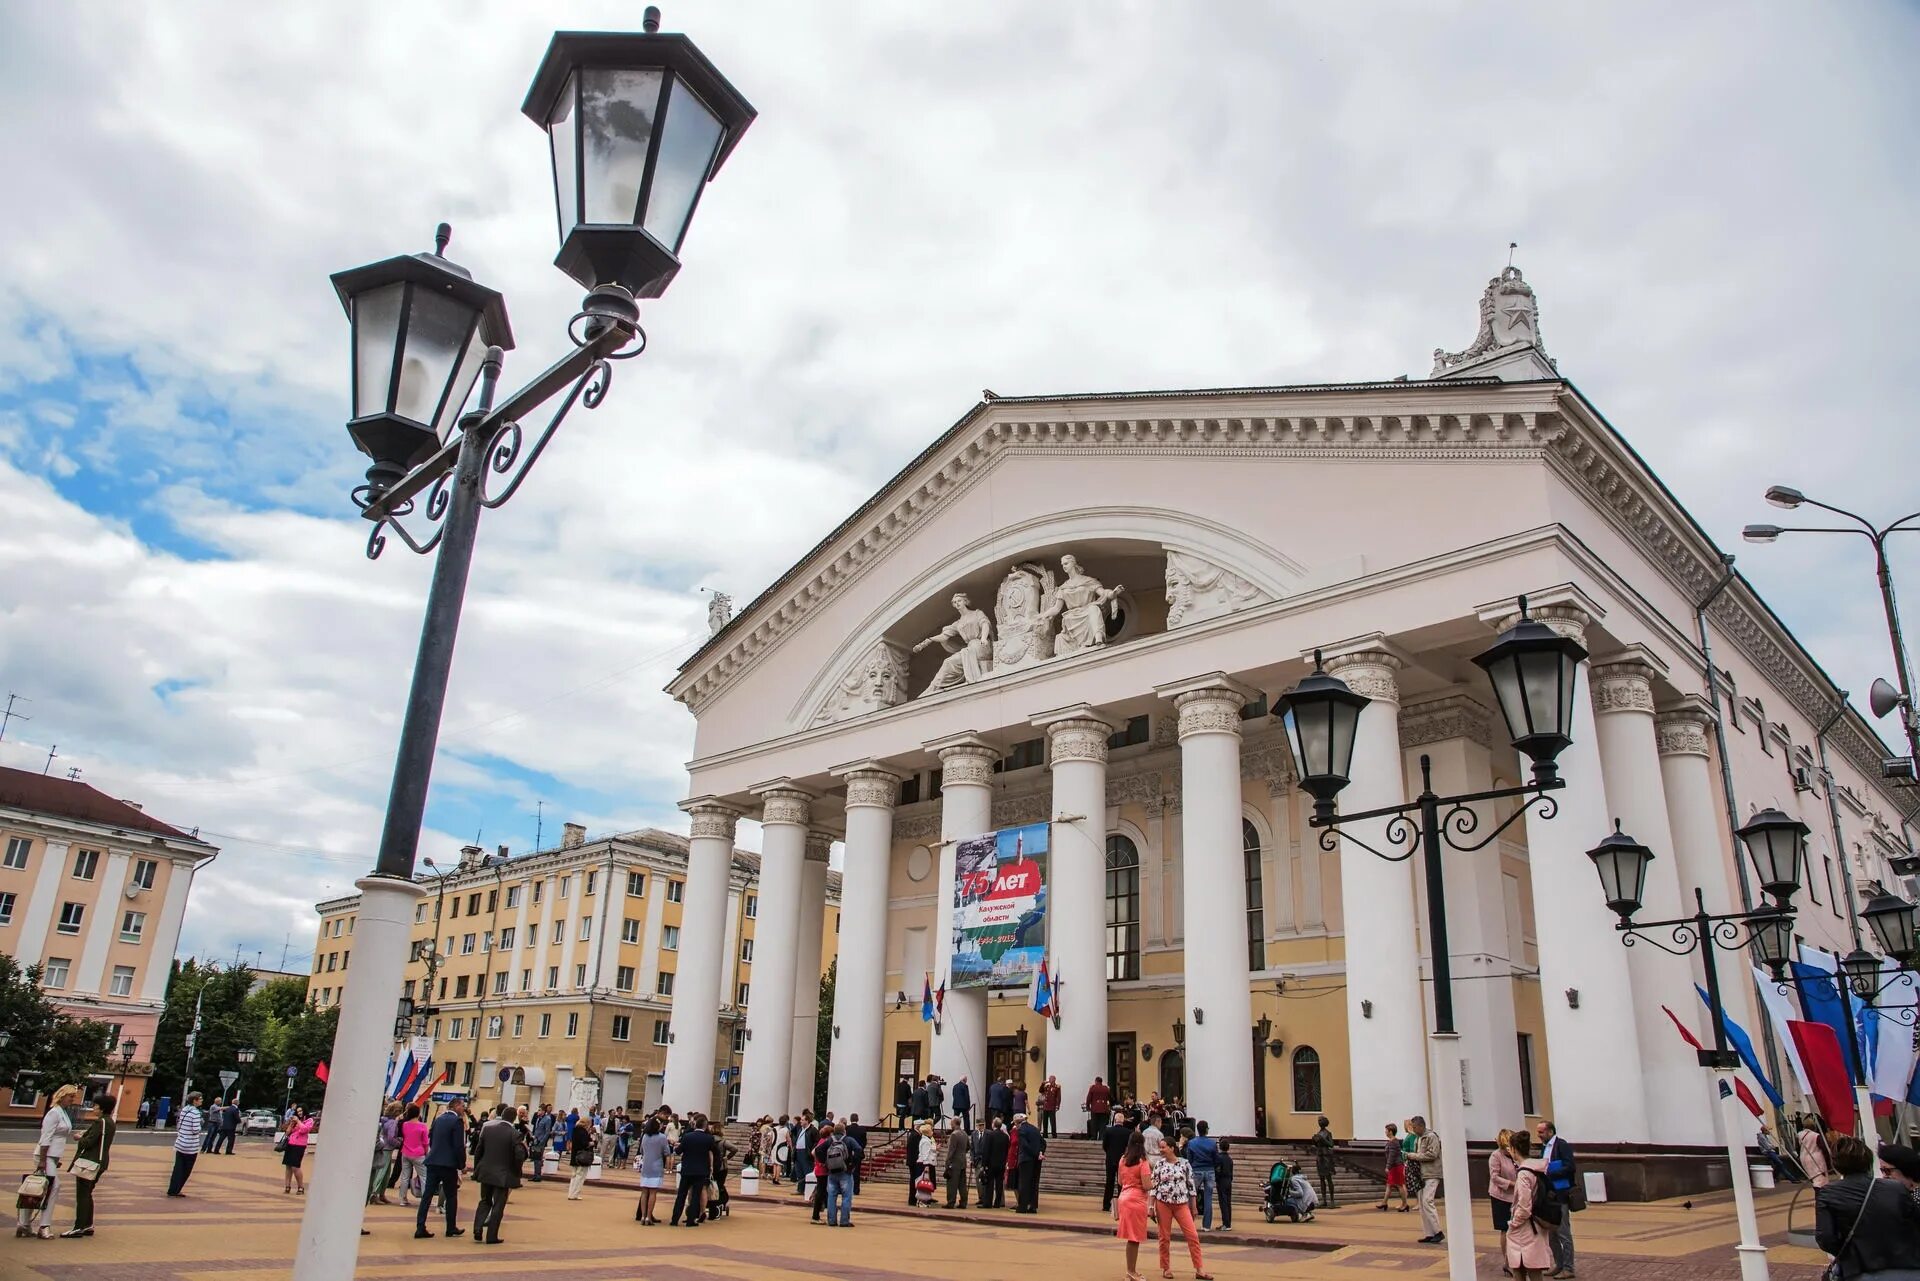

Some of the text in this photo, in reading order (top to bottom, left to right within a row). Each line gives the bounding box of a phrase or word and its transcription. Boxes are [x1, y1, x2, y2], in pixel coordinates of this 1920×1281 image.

[961, 870, 1028, 897] 75 лет
[978, 902, 1015, 913] Калужской
[983, 915, 1009, 923] области
